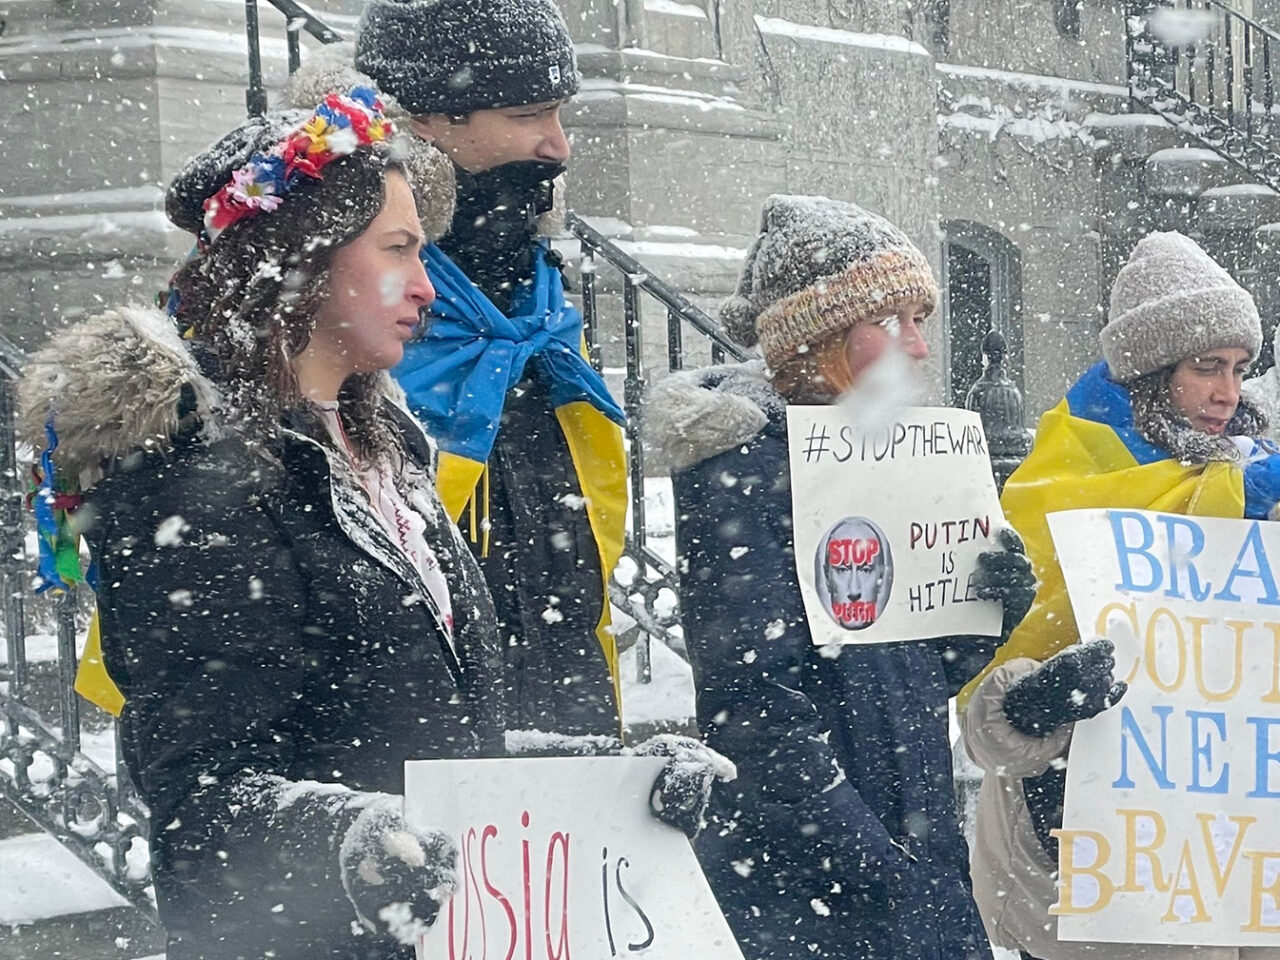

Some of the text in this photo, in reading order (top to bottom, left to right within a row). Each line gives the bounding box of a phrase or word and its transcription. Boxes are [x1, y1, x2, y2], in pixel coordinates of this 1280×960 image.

[803, 422, 986, 462] #STOPTHEWAR
[910, 515, 990, 550] PUTIN
[829, 538, 879, 566] STOP
[941, 551, 955, 575] IS
[909, 570, 978, 612] HITLE
